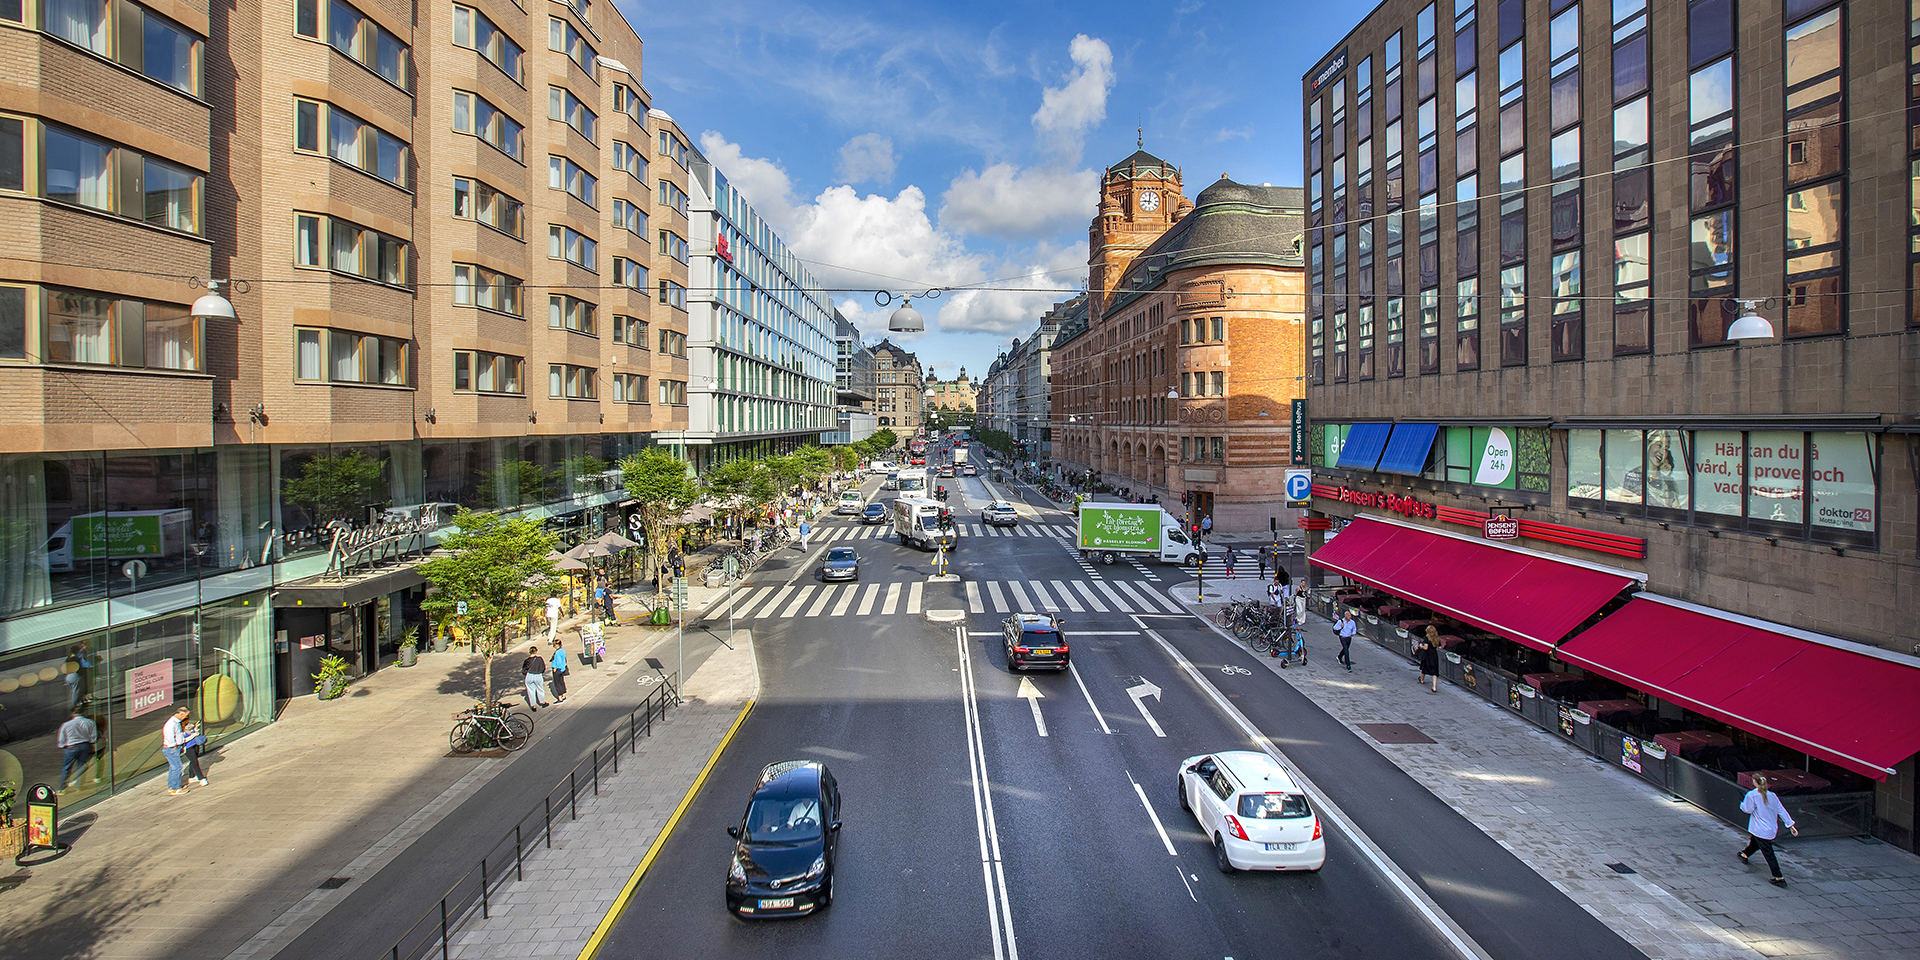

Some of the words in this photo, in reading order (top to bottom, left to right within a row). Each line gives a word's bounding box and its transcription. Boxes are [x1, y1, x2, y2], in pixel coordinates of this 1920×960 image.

[1487, 444, 1509, 458] Open
[1715, 442, 1742, 457] Här
[1778, 444, 1799, 459] du
[1695, 458, 1732, 477] vård,
[1811, 467, 1845, 482] och
[1292, 477, 1309, 497] P
[1339, 485, 1386, 509] Jensen's
[1387, 493, 1434, 518] Bøfhus
[134, 690, 164, 710] HIGH
